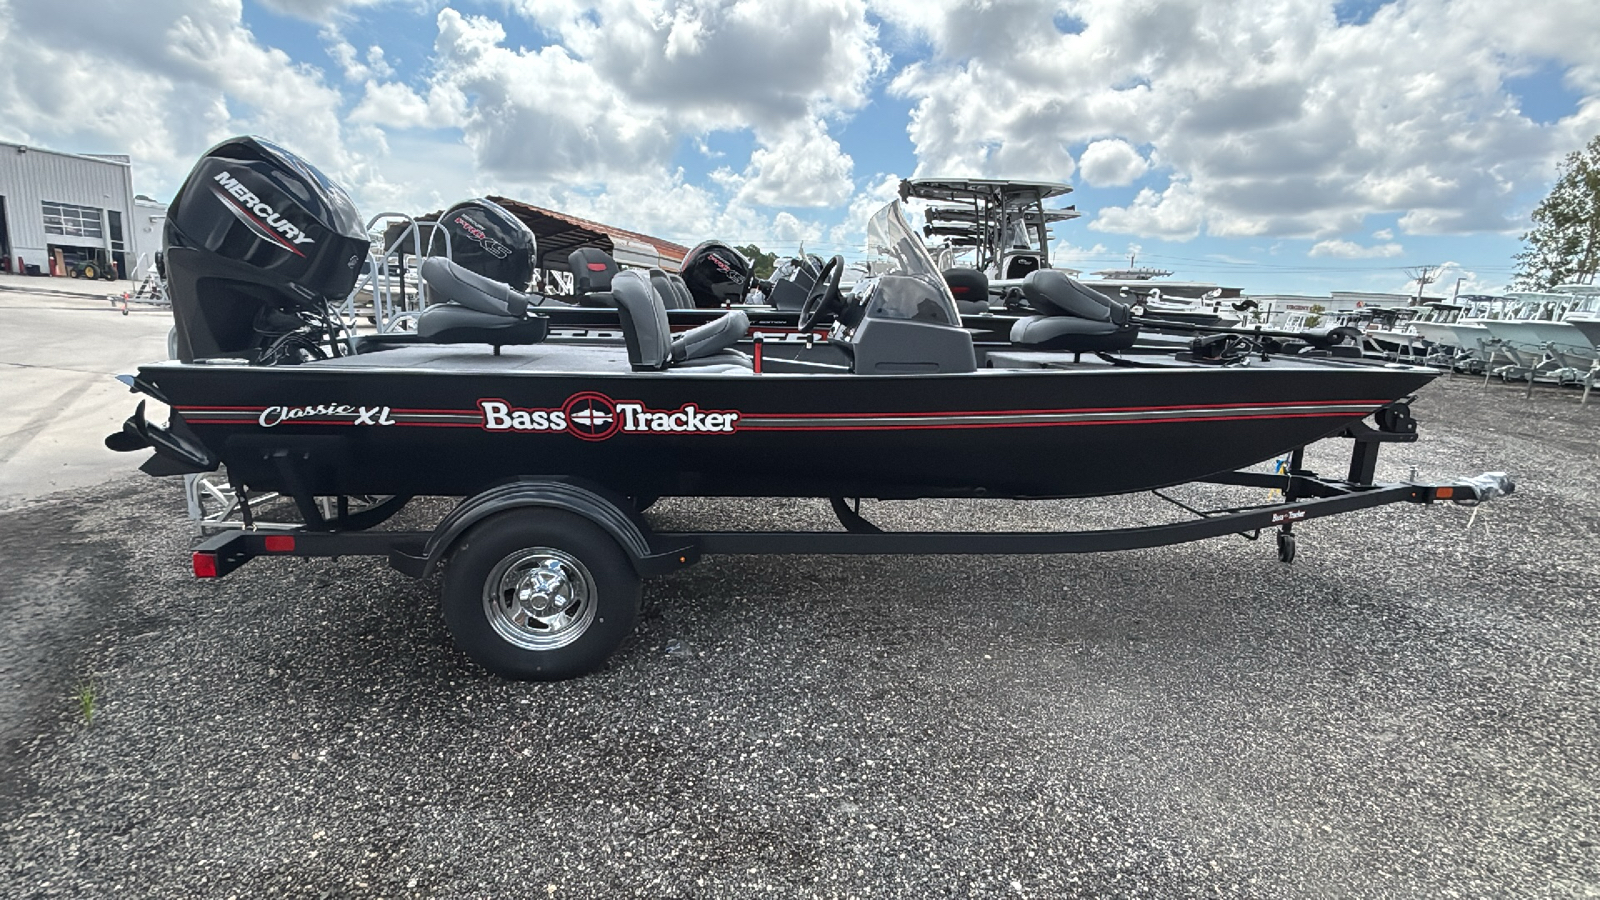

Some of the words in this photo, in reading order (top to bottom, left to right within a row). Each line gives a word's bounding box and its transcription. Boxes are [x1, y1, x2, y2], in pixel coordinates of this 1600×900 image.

[213, 171, 315, 245] MERCURY
[258, 402, 355, 428] Classic
[354, 406, 396, 426] XL
[481, 402, 567, 429] Bass
[616, 403, 739, 431] Tracker
